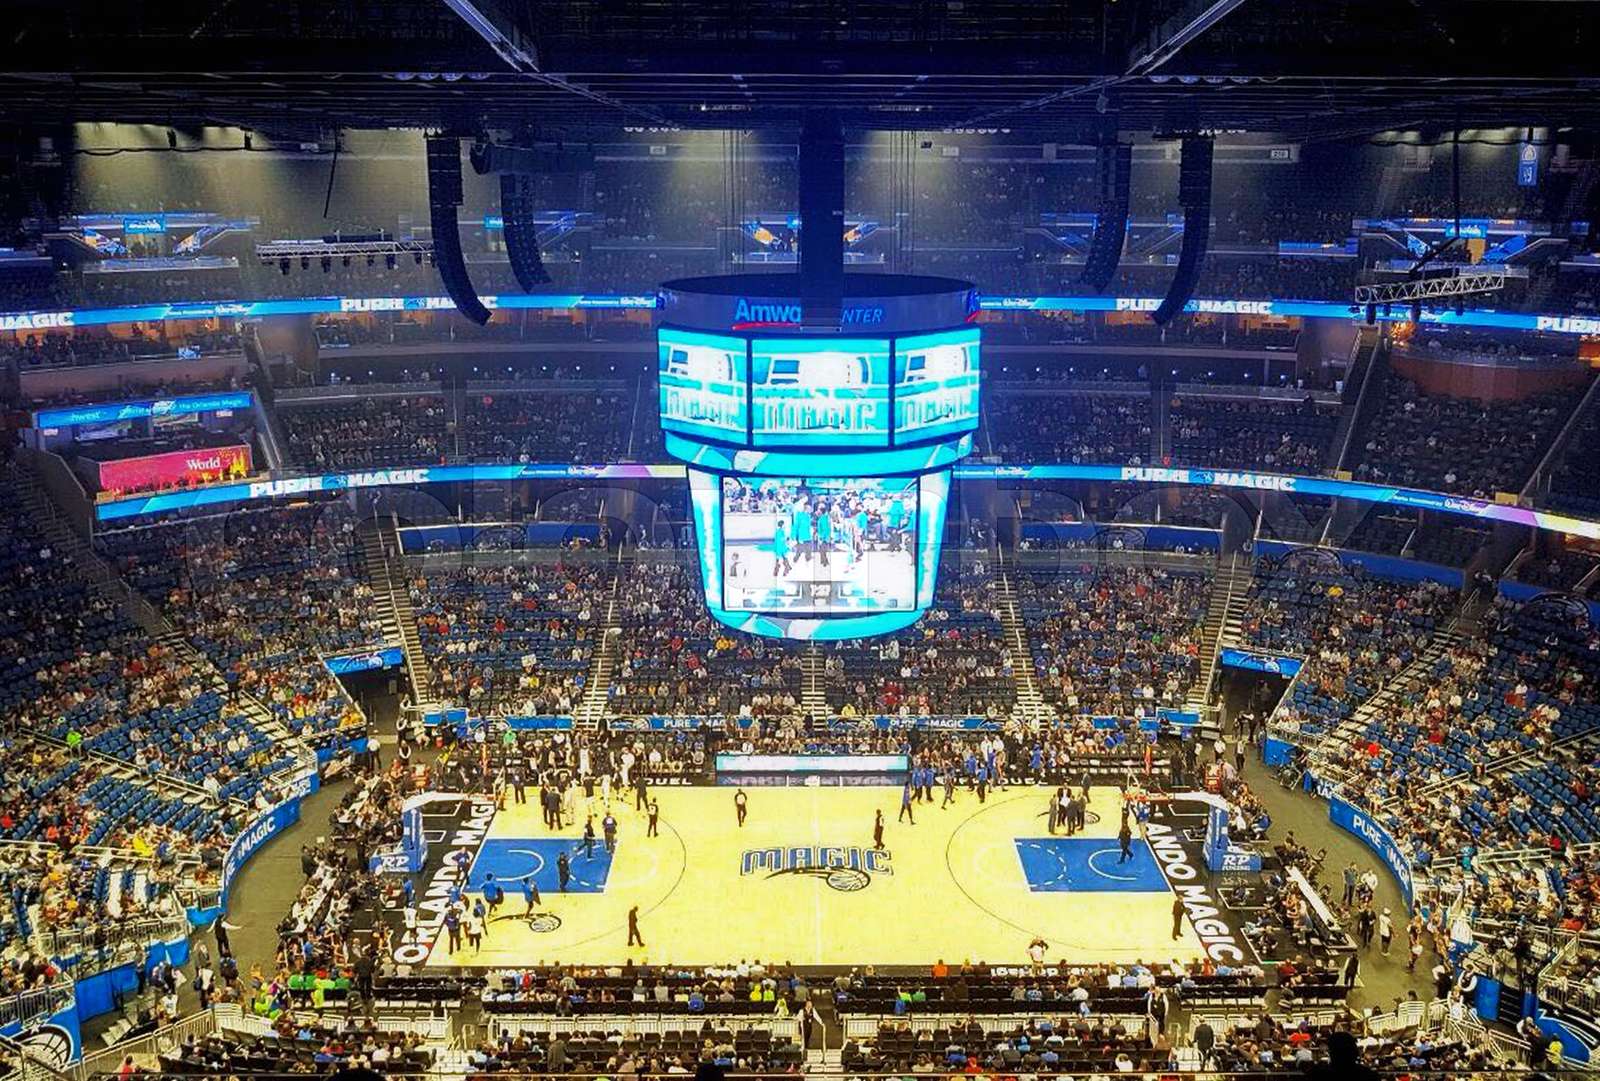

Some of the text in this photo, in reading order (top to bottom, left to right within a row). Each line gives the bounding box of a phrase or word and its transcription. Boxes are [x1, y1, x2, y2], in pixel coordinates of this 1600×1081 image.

[735, 299, 882, 323] Amwa NTER
[1199, 301, 1272, 315] MAGIC
[186, 457, 220, 470] World
[1213, 472, 1296, 492] MAGIC
[930, 719, 965, 728] MAGIC
[1353, 813, 1382, 849] PURE
[239, 824, 276, 867] MAGIC
[741, 847, 893, 875] MAGIC
[1222, 855, 1250, 867] RP
[1174, 885, 1244, 961] MAGIC
